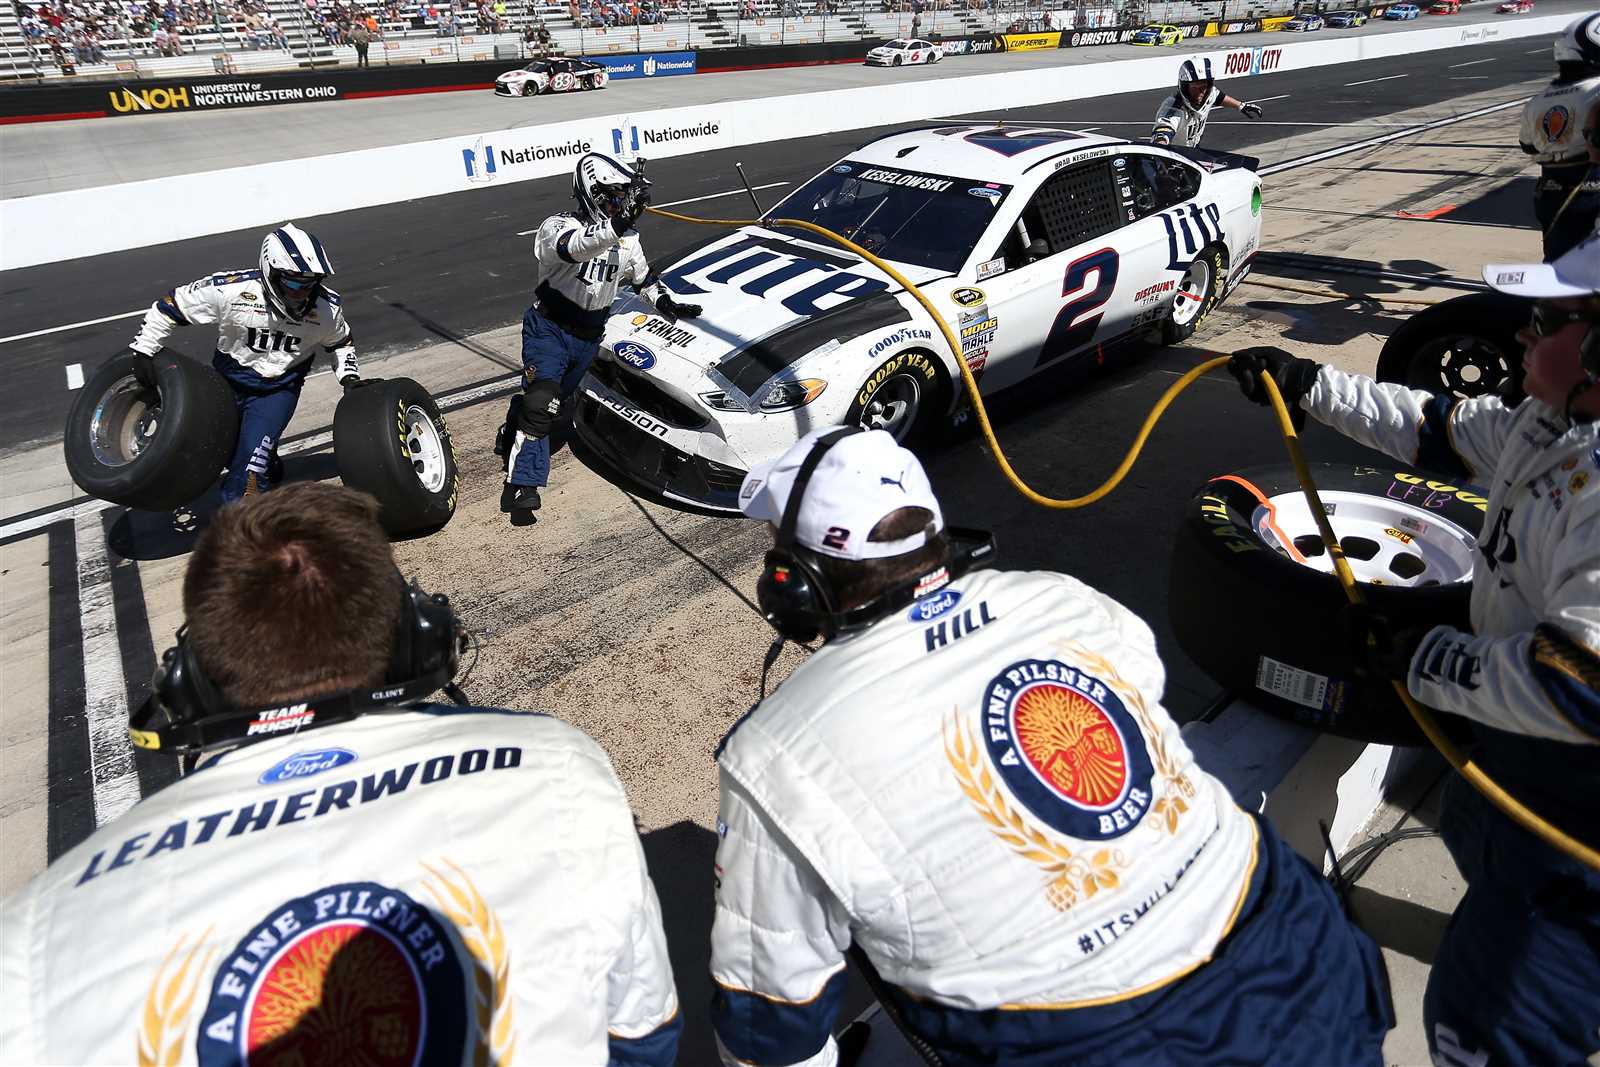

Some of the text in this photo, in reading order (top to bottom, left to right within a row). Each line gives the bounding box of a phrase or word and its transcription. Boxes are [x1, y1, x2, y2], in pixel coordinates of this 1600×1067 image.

[970, 39, 993, 52] Sprint
[1010, 38, 1048, 48] CUP SERIES
[1080, 30, 1118, 46] BRISTOL
[657, 60, 692, 70] Nationwide
[910, 51, 920, 62] 6
[1224, 52, 1251, 74] FOOD
[1261, 49, 1282, 70] CITY
[192, 82, 250, 94] UNIVERSITY
[554, 72, 573, 89] 83
[109, 86, 190, 113] UNOH
[194, 86, 337, 106] NORTHWESTERN OHIO
[643, 122, 719, 145] Nationwide
[501, 139, 591, 167] Nationwide
[1054, 148, 1109, 171] BRAD KESELOWSKI
[858, 168, 954, 193] KESELOWSKI
[1151, 202, 1226, 271] Lite
[659, 233, 891, 316] Lite
[1134, 279, 1176, 302] DISCOUNT
[1141, 294, 1161, 307] TIRE
[1034, 246, 1120, 371] 2
[642, 318, 697, 348] PENNZOIL
[962, 319, 997, 338] MOOG
[962, 332, 994, 353] MAHLE
[618, 345, 649, 367] Ford
[601, 396, 668, 437] FUSION
[822, 526, 850, 549] 2
[919, 595, 953, 620] Ford
[924, 601, 997, 653] HILL
[372, 688, 405, 700] CLINT
[257, 703, 309, 722] TEAM
[989, 663, 1108, 767] A FINE PILSNER
[246, 713, 315, 736] PENSKE
[277, 755, 343, 780] Ford
[75, 746, 522, 888] LEATHERWOOD
[1099, 787, 1148, 835] BEER
[206, 889, 444, 1043] A FINE PILSNER
